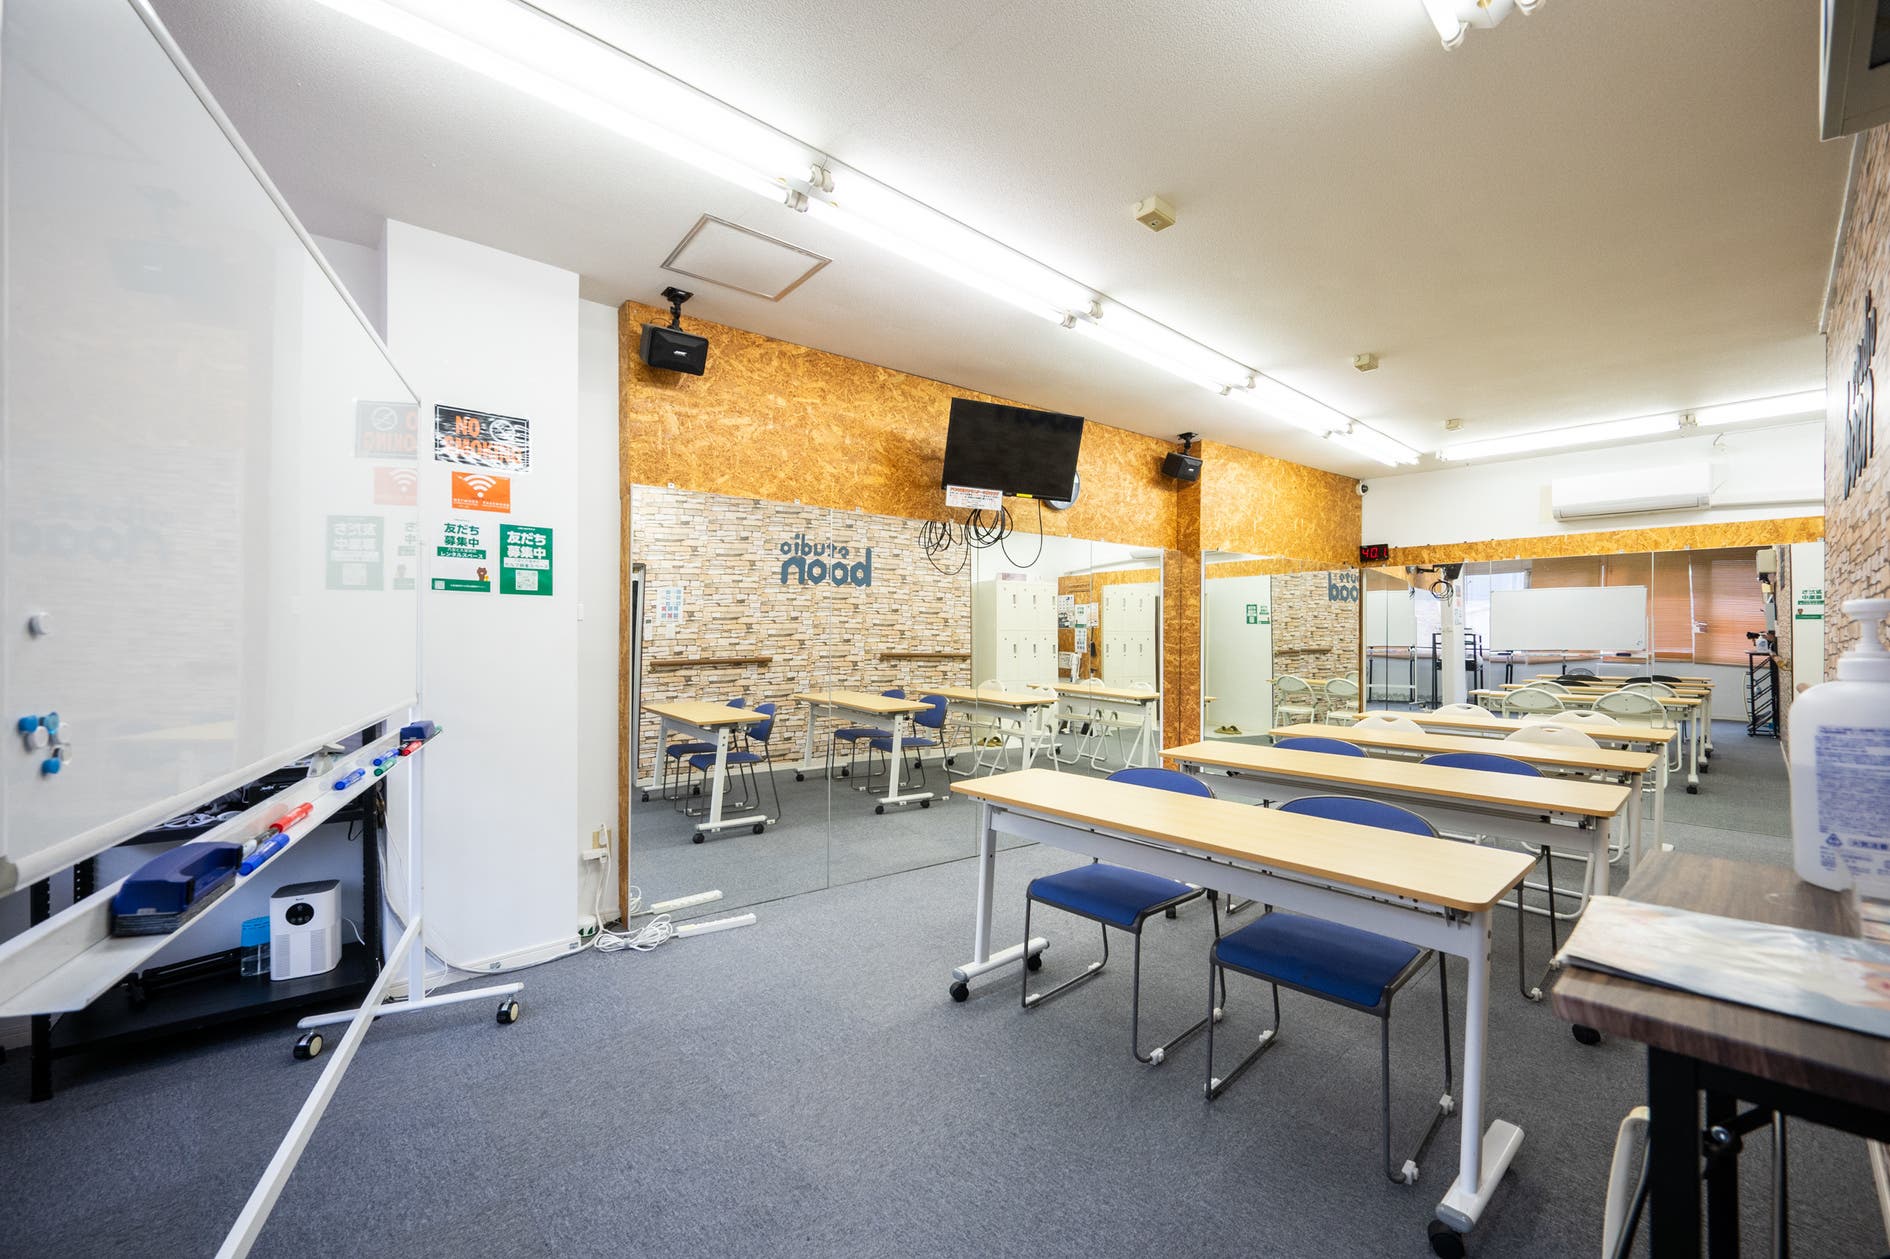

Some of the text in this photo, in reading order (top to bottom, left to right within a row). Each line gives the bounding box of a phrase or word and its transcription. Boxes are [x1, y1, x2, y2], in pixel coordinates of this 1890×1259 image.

[455, 415, 481, 438] NO
[444, 522, 480, 536] 友だち
[444, 535, 480, 548] 募集中
[506, 530, 547, 546] 友だち
[506, 545, 547, 560] 募集中
